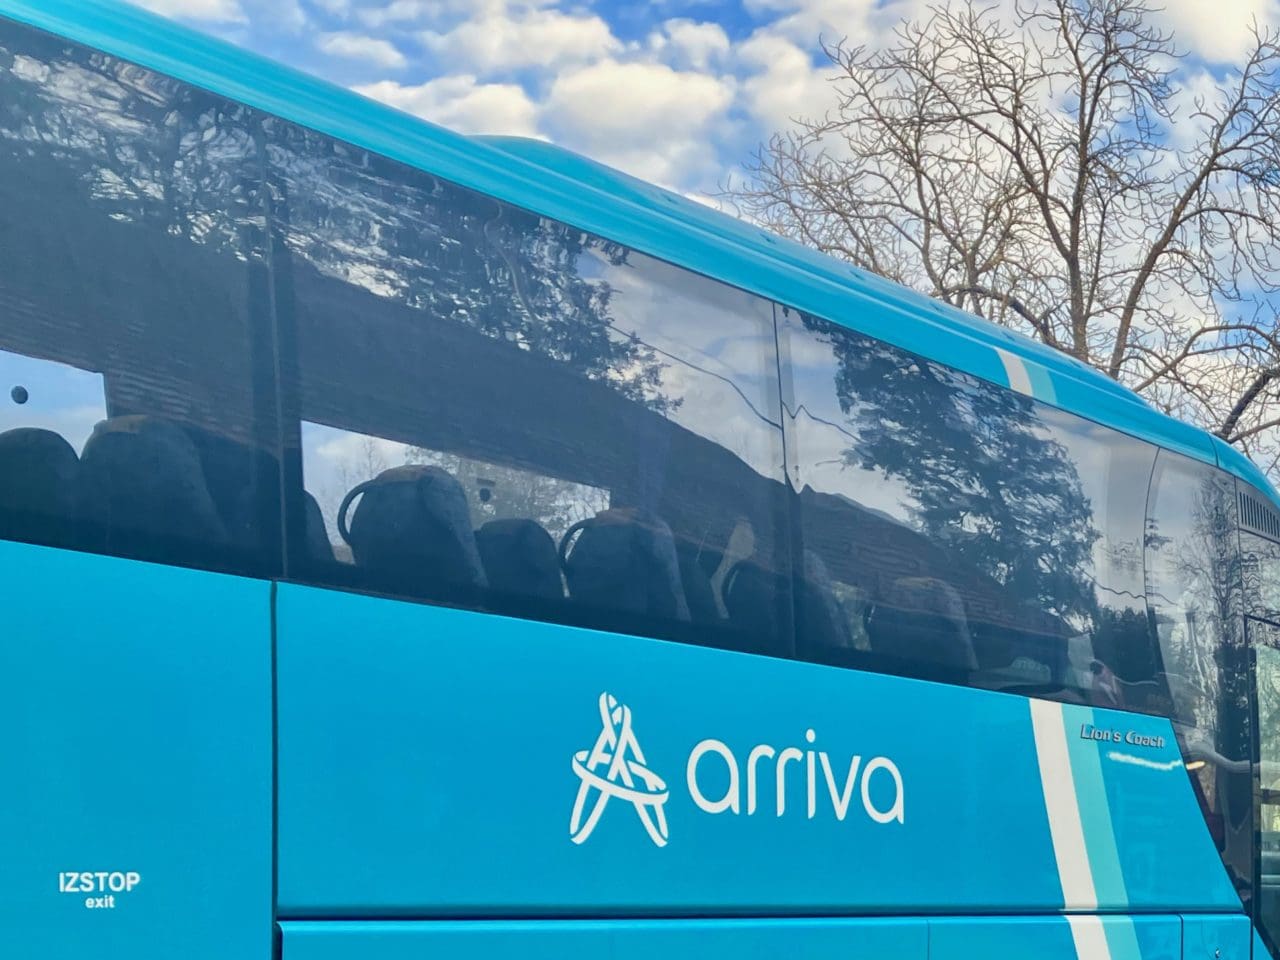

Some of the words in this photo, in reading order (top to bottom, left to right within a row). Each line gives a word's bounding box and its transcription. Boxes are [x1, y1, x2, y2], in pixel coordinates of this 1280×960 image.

[1081, 723, 1121, 743] Lion's
[1125, 730, 1165, 748] Coach
[687, 729, 904, 824] arriva
[59, 872, 140, 892] IZSTOP
[85, 895, 115, 908] exit
